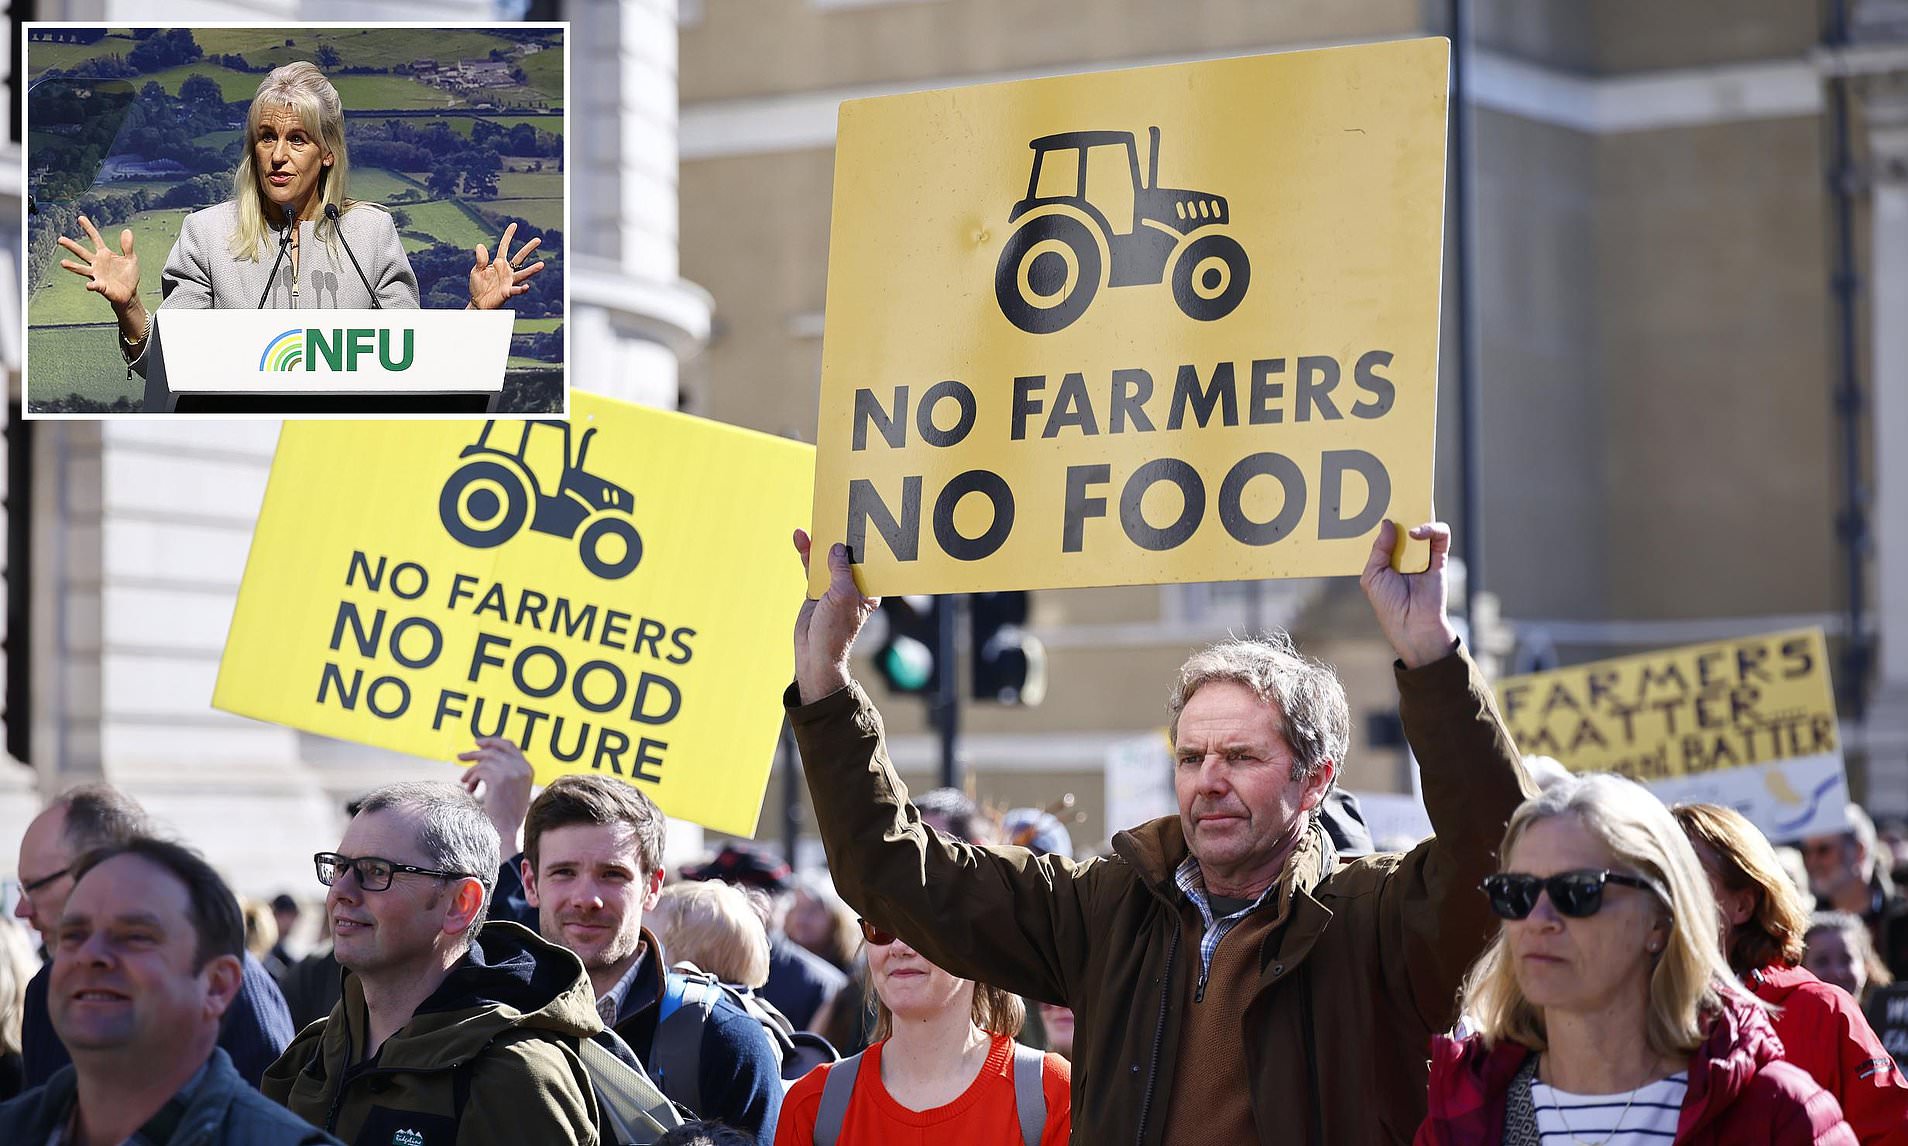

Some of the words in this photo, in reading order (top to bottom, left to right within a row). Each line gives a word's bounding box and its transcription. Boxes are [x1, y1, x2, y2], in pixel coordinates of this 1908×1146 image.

[305, 328, 415, 372] NFU
[851, 379, 977, 452] NO
[1010, 350, 1397, 442] FARMERS
[846, 469, 1016, 565] NO
[1062, 449, 1392, 554] FOOD
[345, 550, 430, 601] NO
[447, 573, 699, 667] FARMERS
[329, 600, 445, 671] NO
[467, 631, 683, 727] FOOD
[1503, 638, 1814, 720] FARMERS
[316, 661, 412, 721] NO
[432, 688, 670, 786] FUTURE
[1681, 712, 1836, 775] BATTER
